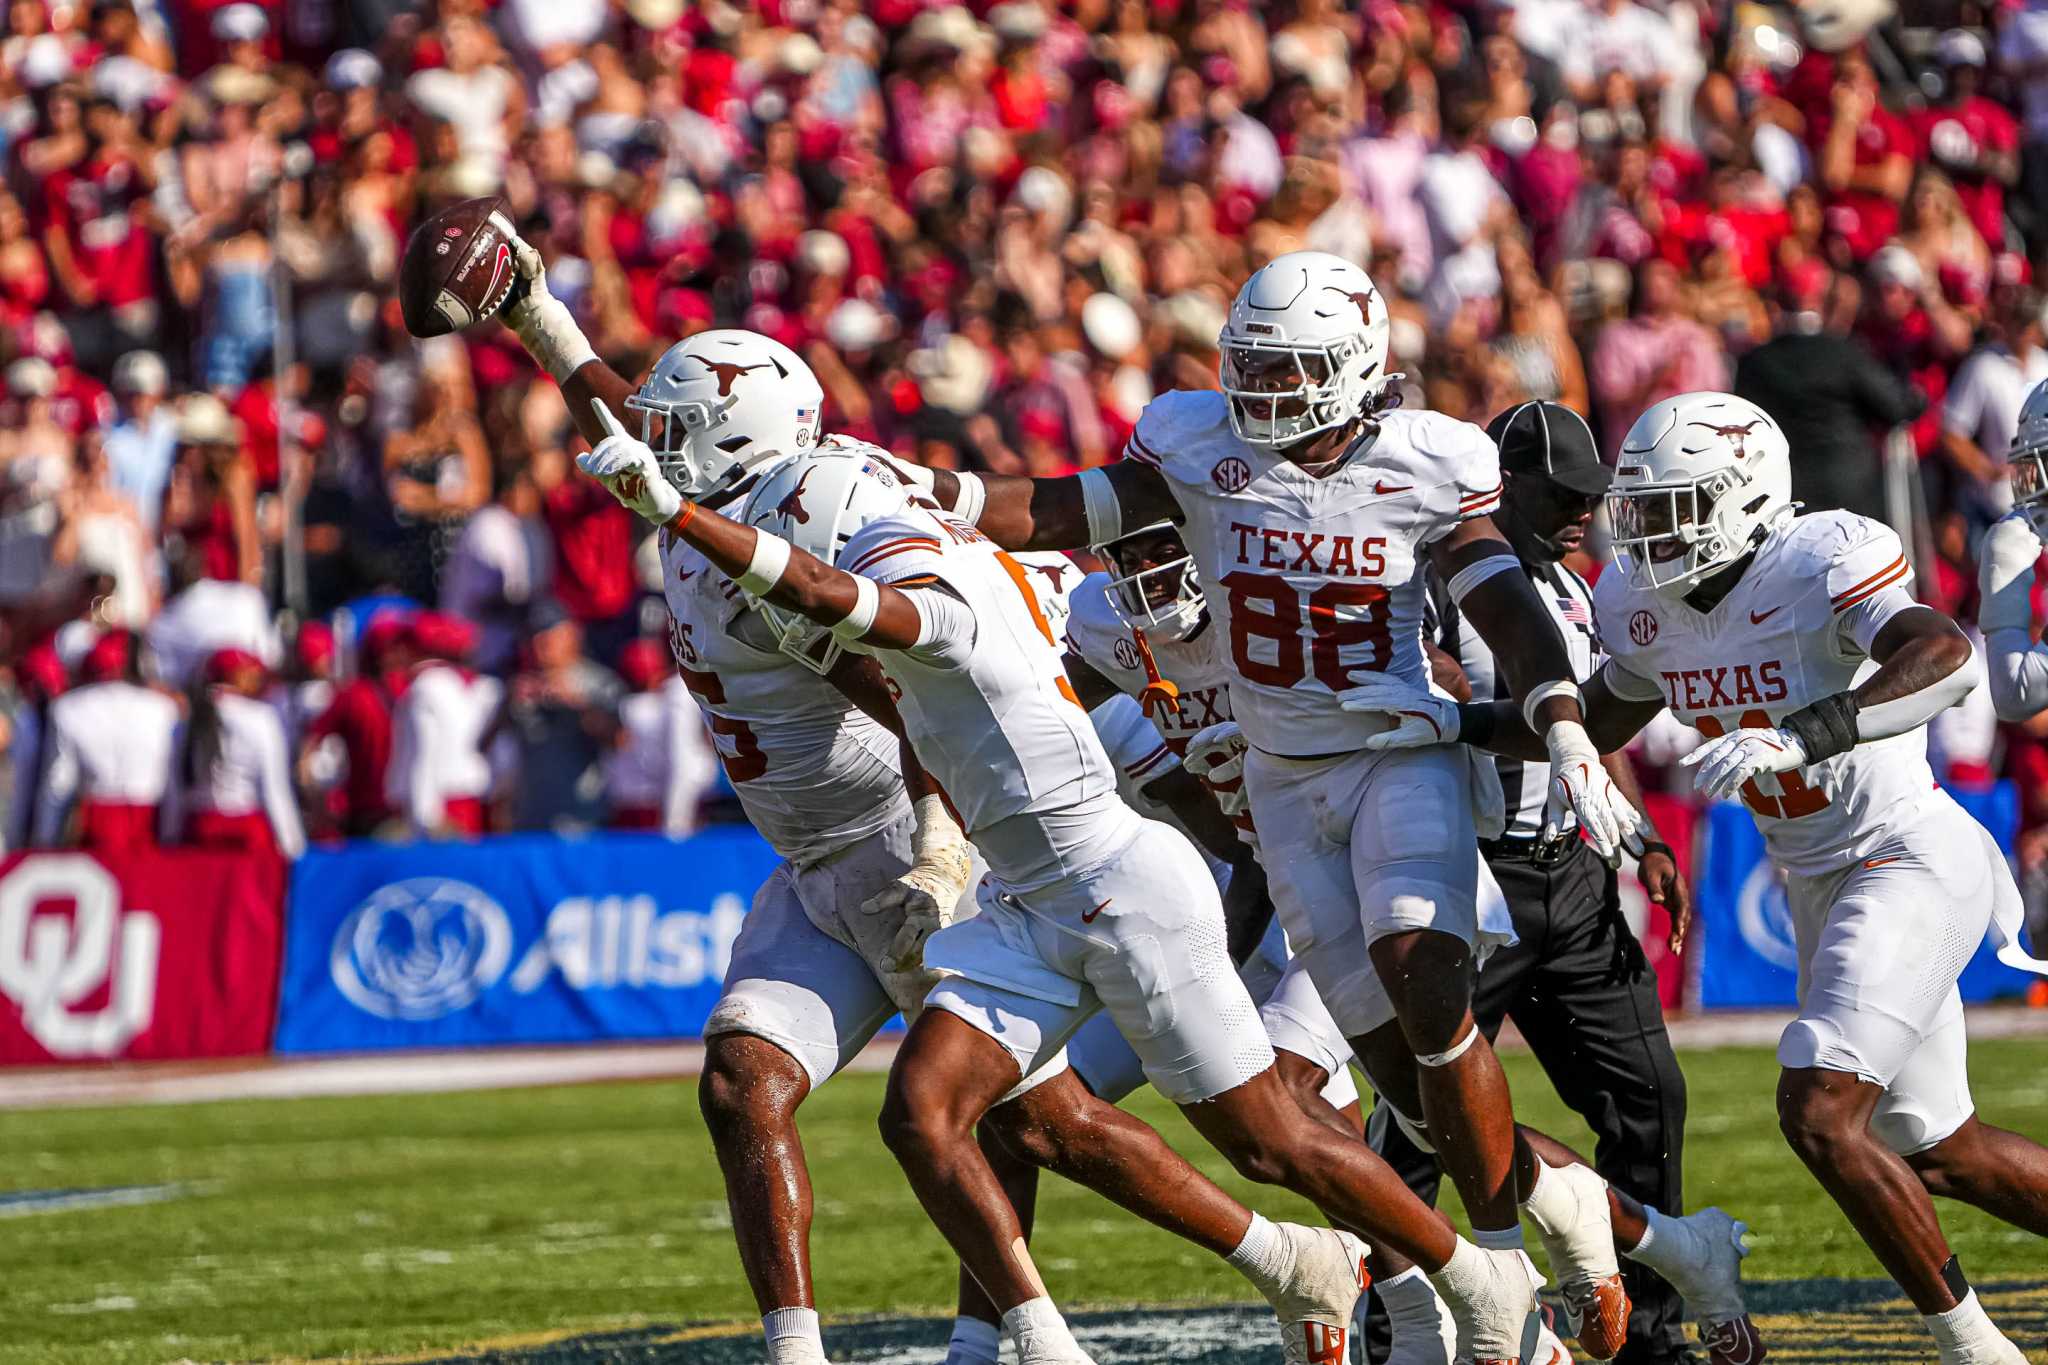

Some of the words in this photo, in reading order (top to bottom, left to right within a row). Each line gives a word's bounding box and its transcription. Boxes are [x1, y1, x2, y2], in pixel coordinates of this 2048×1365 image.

[1215, 458, 1250, 491] SEC
[1231, 522, 1387, 577] TEXAS
[1219, 571, 1394, 692] 88
[1631, 611, 1658, 645] SEC
[1660, 660, 1787, 710] TEXAS
[0, 852, 160, 1058] OU
[510, 892, 747, 994] Allst
